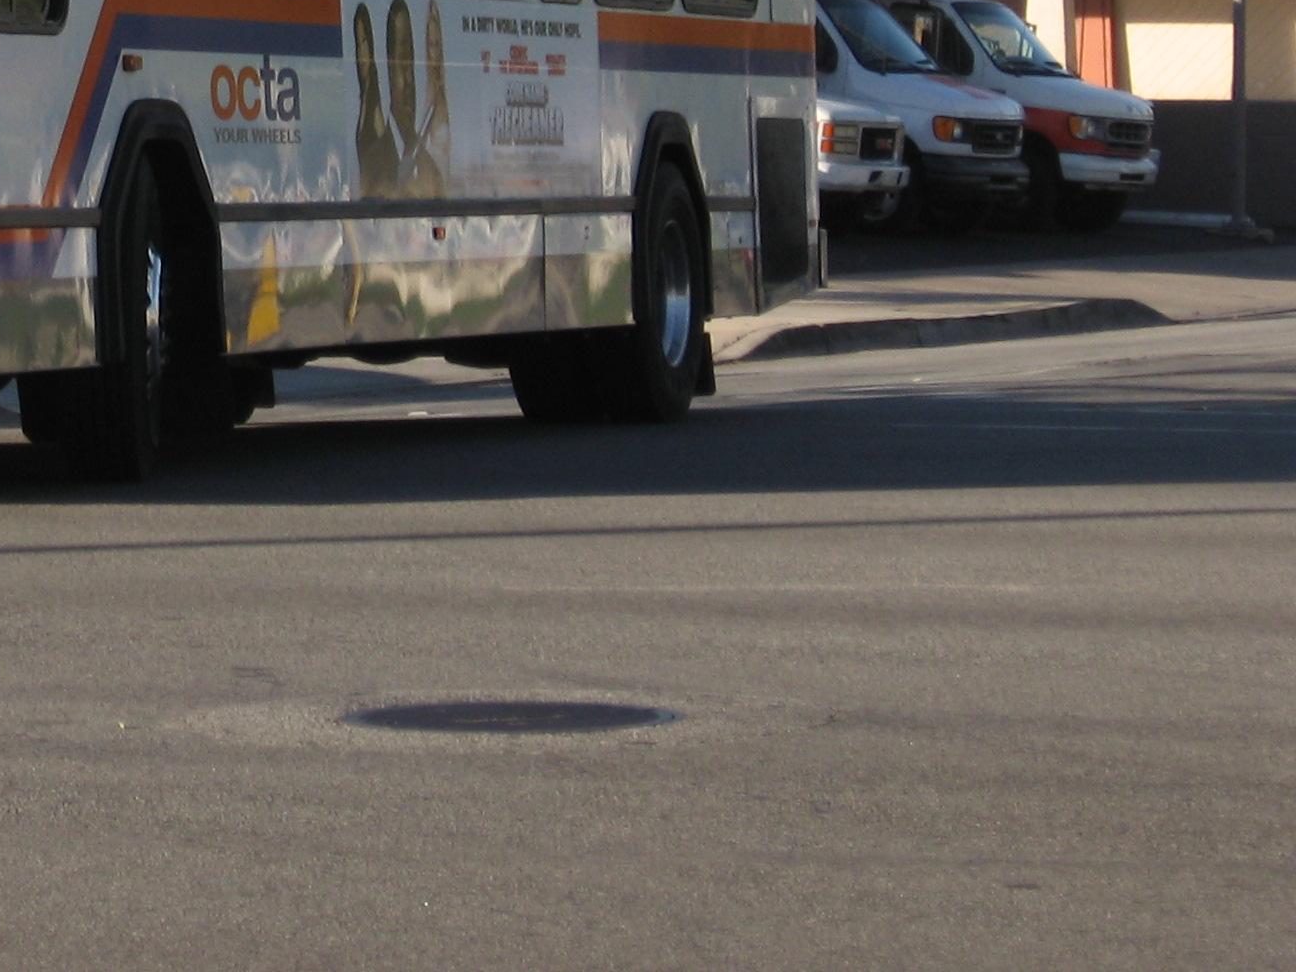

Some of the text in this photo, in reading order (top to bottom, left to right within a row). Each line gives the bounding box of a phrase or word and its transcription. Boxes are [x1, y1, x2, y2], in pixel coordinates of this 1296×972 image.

[210, 50, 301, 122] octa
[213, 128, 302, 145] YOUR WHEELS
